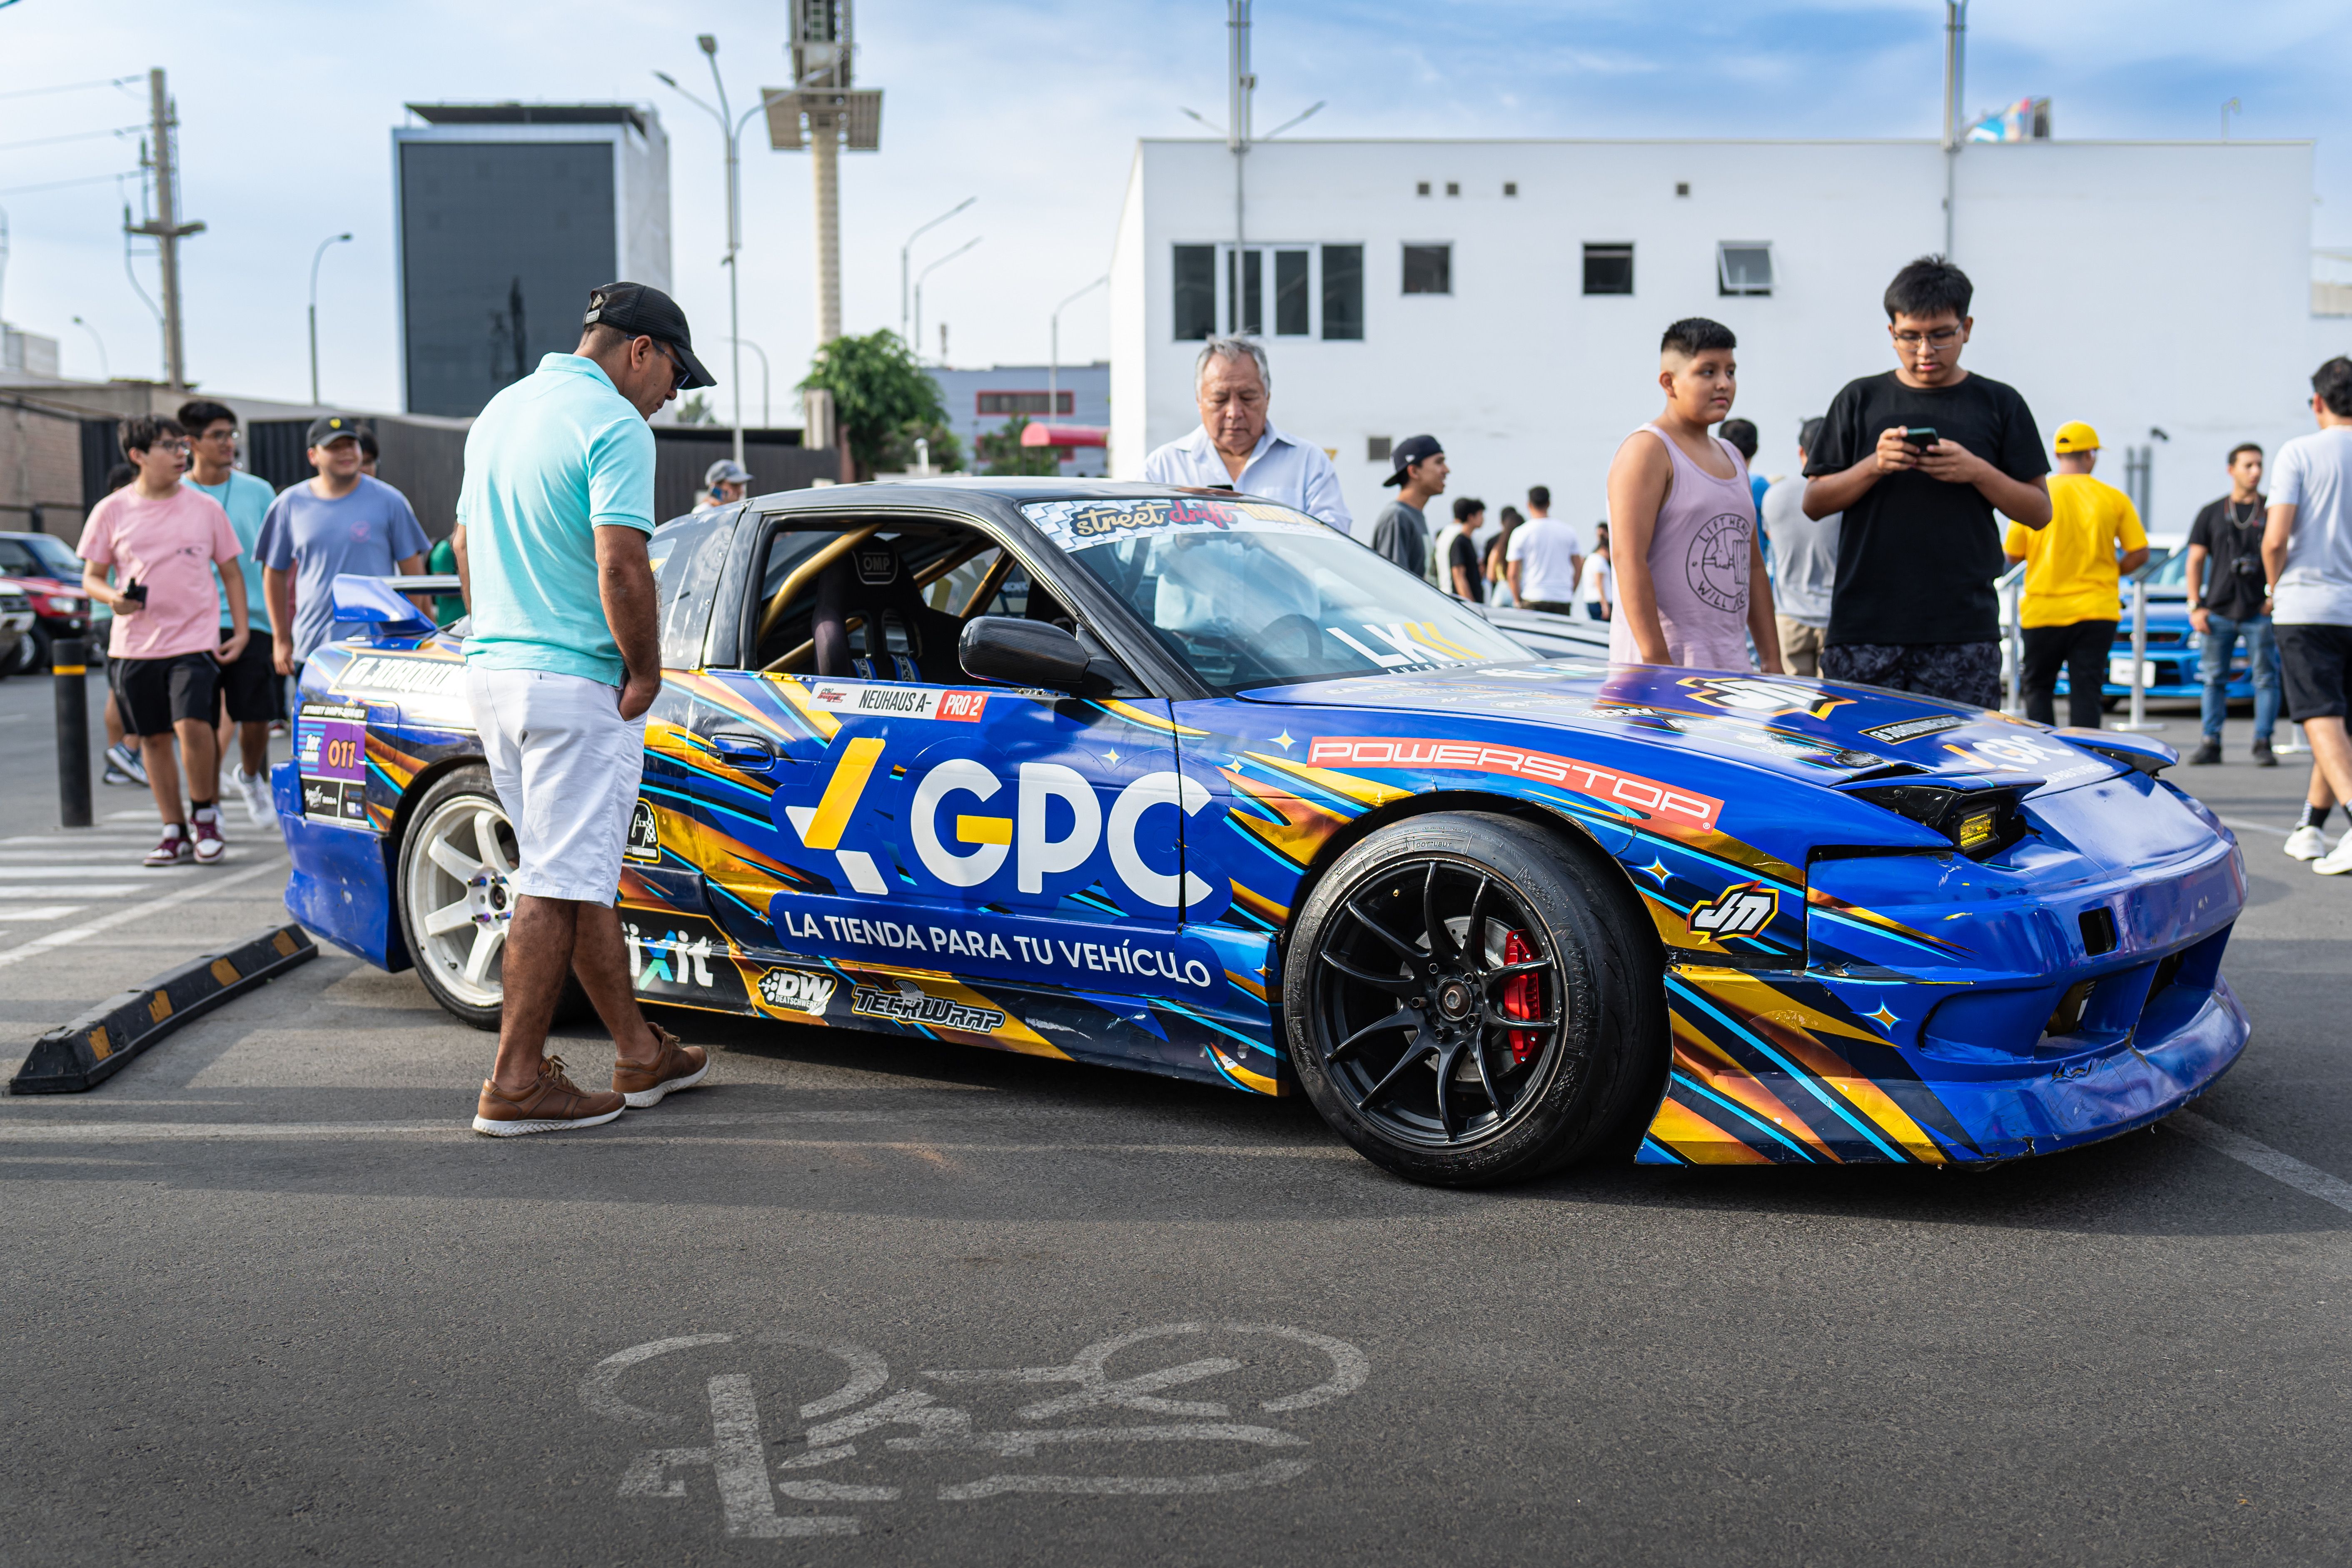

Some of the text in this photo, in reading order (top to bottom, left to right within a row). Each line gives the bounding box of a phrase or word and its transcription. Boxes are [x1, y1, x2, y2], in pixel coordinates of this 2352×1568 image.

[1077, 502, 1172, 535] street
[1169, 500, 1240, 528] drift
[1699, 517, 1725, 542] LIFT
[863, 557, 890, 571] OMP
[1697, 580, 1726, 608] WILL
[858, 689, 915, 711] NEUHAUS
[943, 695, 971, 715] PRO
[968, 697, 982, 716] 2
[328, 739, 357, 769] 011
[1972, 735, 2074, 765] GPC
[1311, 741, 1711, 820] POWERSTOP
[910, 758, 1213, 907] GPC
[621, 922, 713, 991] ixit
[784, 911, 1211, 988] LA TIENDA PARA TU VEHÍCULO
[775, 995, 821, 1009] DEATSCHWERK
[776, 973, 832, 1002] DW
